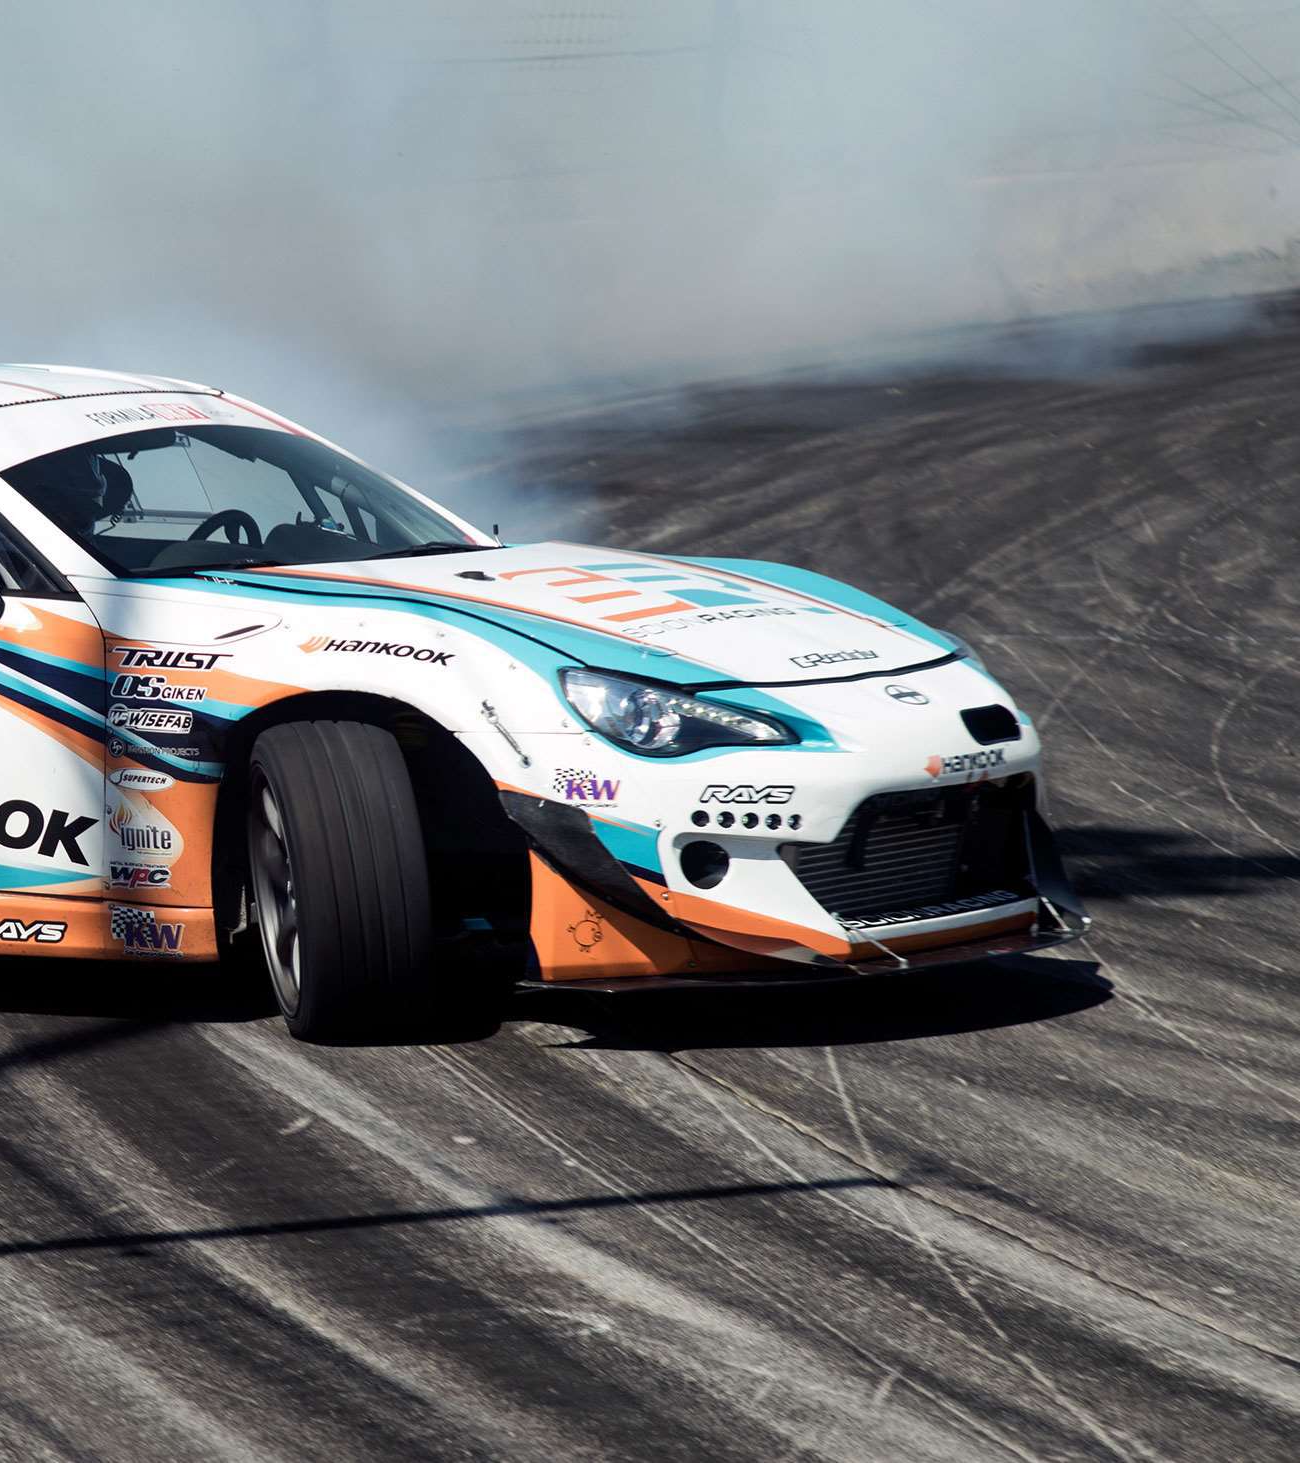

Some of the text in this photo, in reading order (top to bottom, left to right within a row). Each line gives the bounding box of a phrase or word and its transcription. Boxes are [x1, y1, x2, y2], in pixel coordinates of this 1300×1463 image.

[111, 647, 235, 671] TRUST
[161, 686, 206, 701] GIKEN
[128, 711, 193, 729] WISEFAB
[122, 772, 168, 786] SUPERTECH
[564, 779, 621, 801] KW
[700, 784, 796, 805] RAYS
[120, 823, 173, 852] ignite
